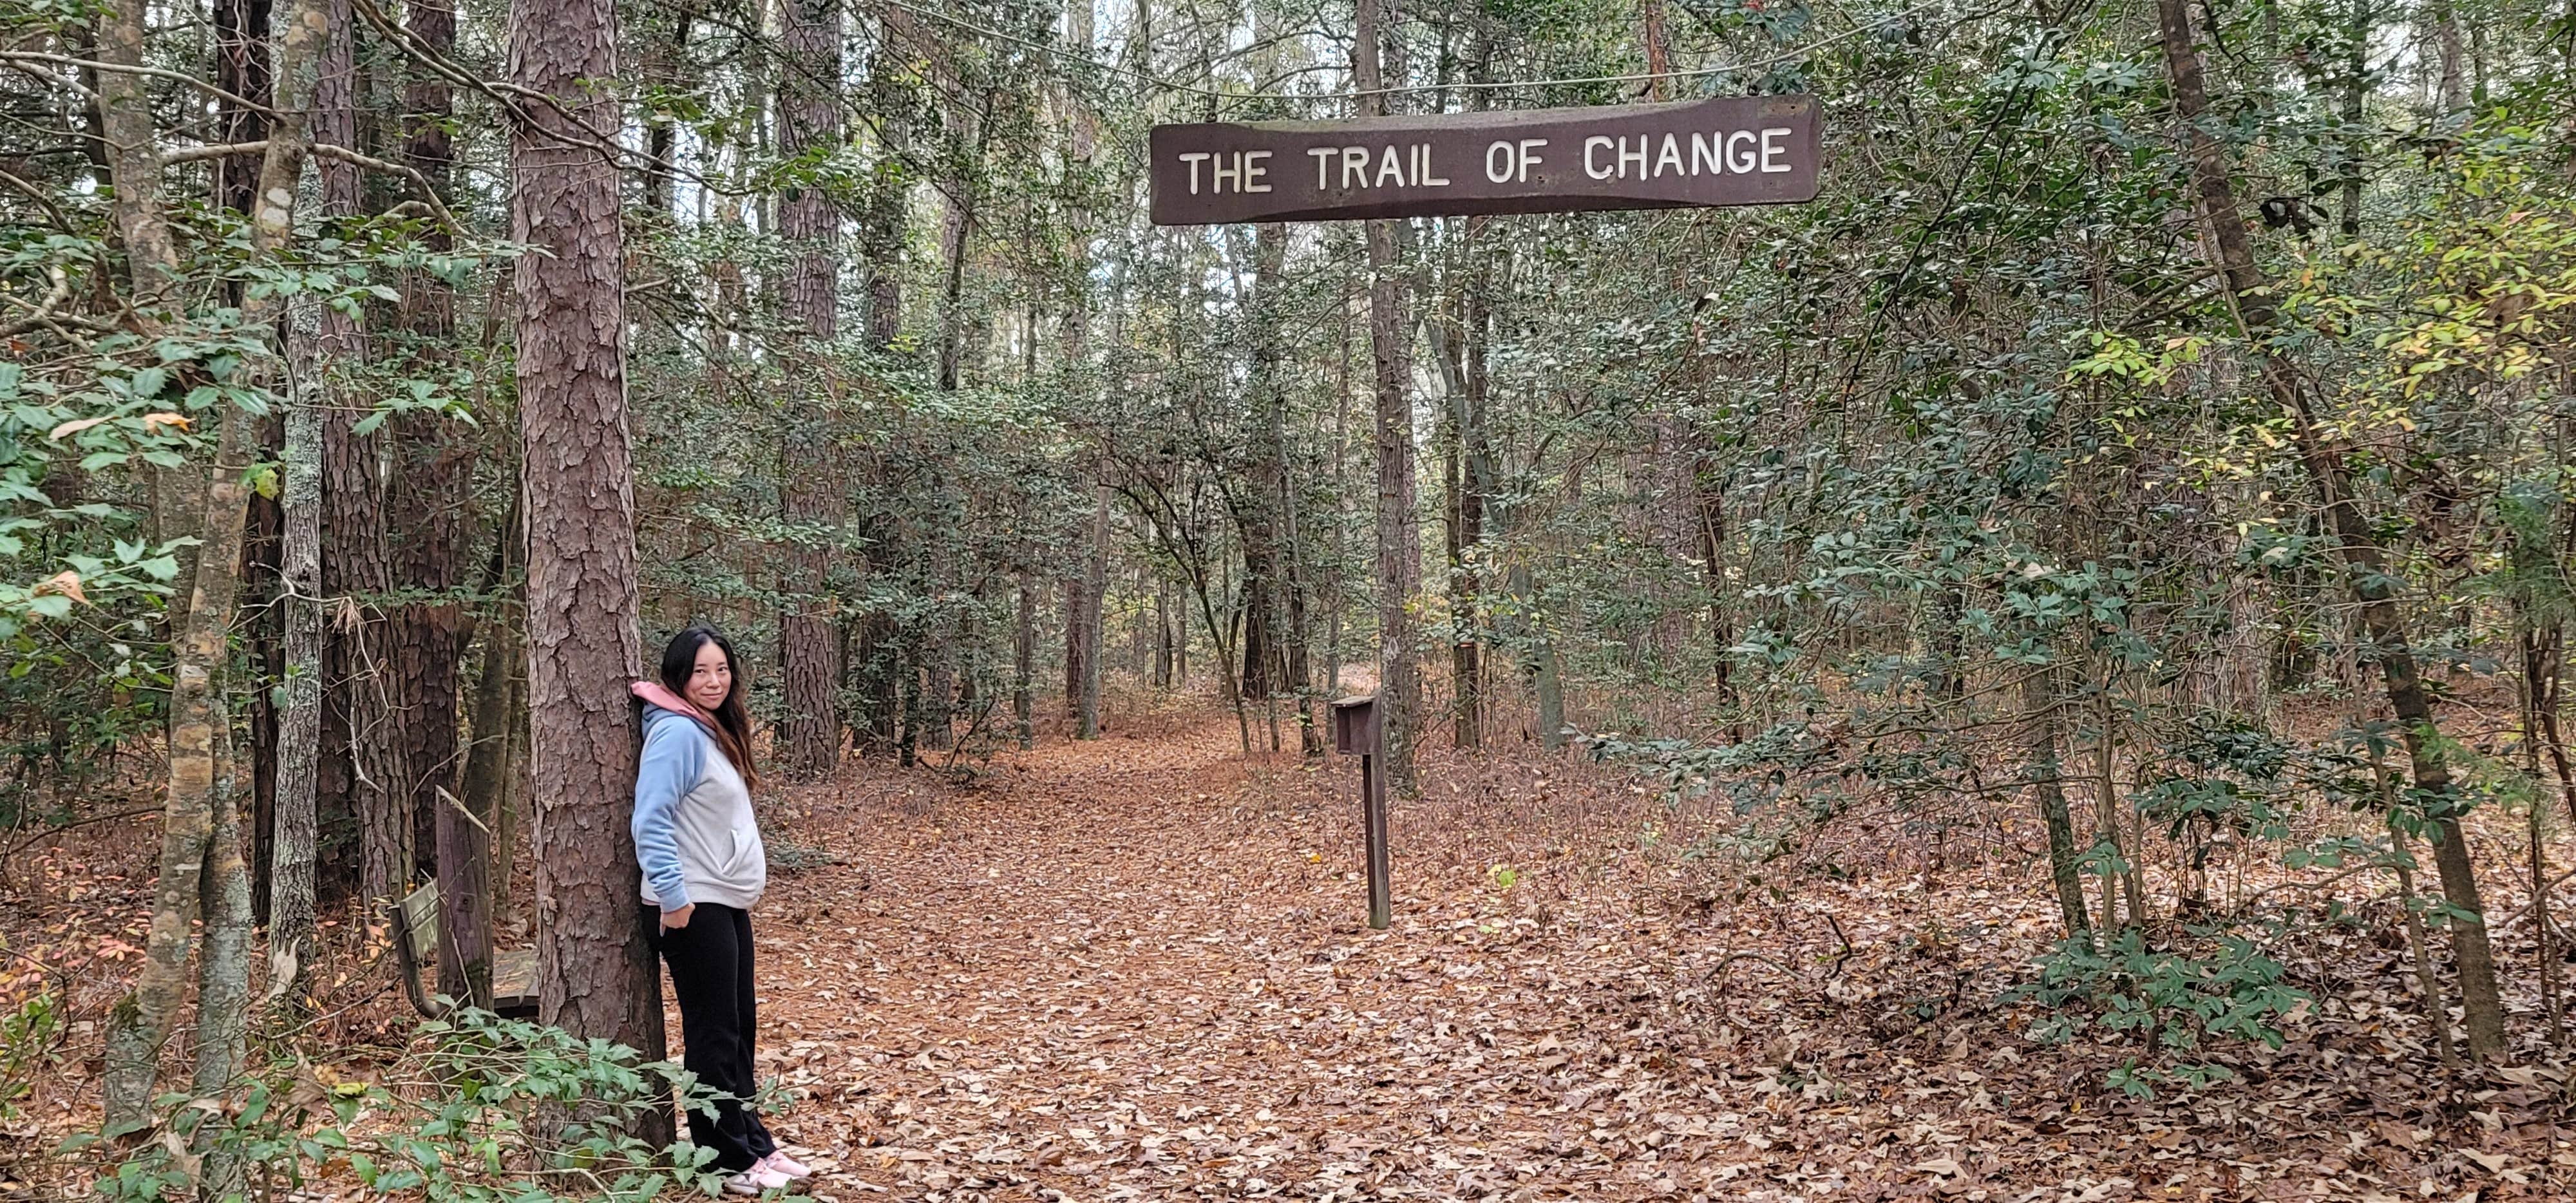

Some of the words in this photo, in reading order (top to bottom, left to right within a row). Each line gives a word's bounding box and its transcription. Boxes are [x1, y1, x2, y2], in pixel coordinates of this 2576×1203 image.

[1179, 151, 1273, 194] THE
[1307, 144, 1450, 190] TRAIL
[1485, 138, 1548, 184] OF
[1584, 127, 1792, 180] CHANGE
